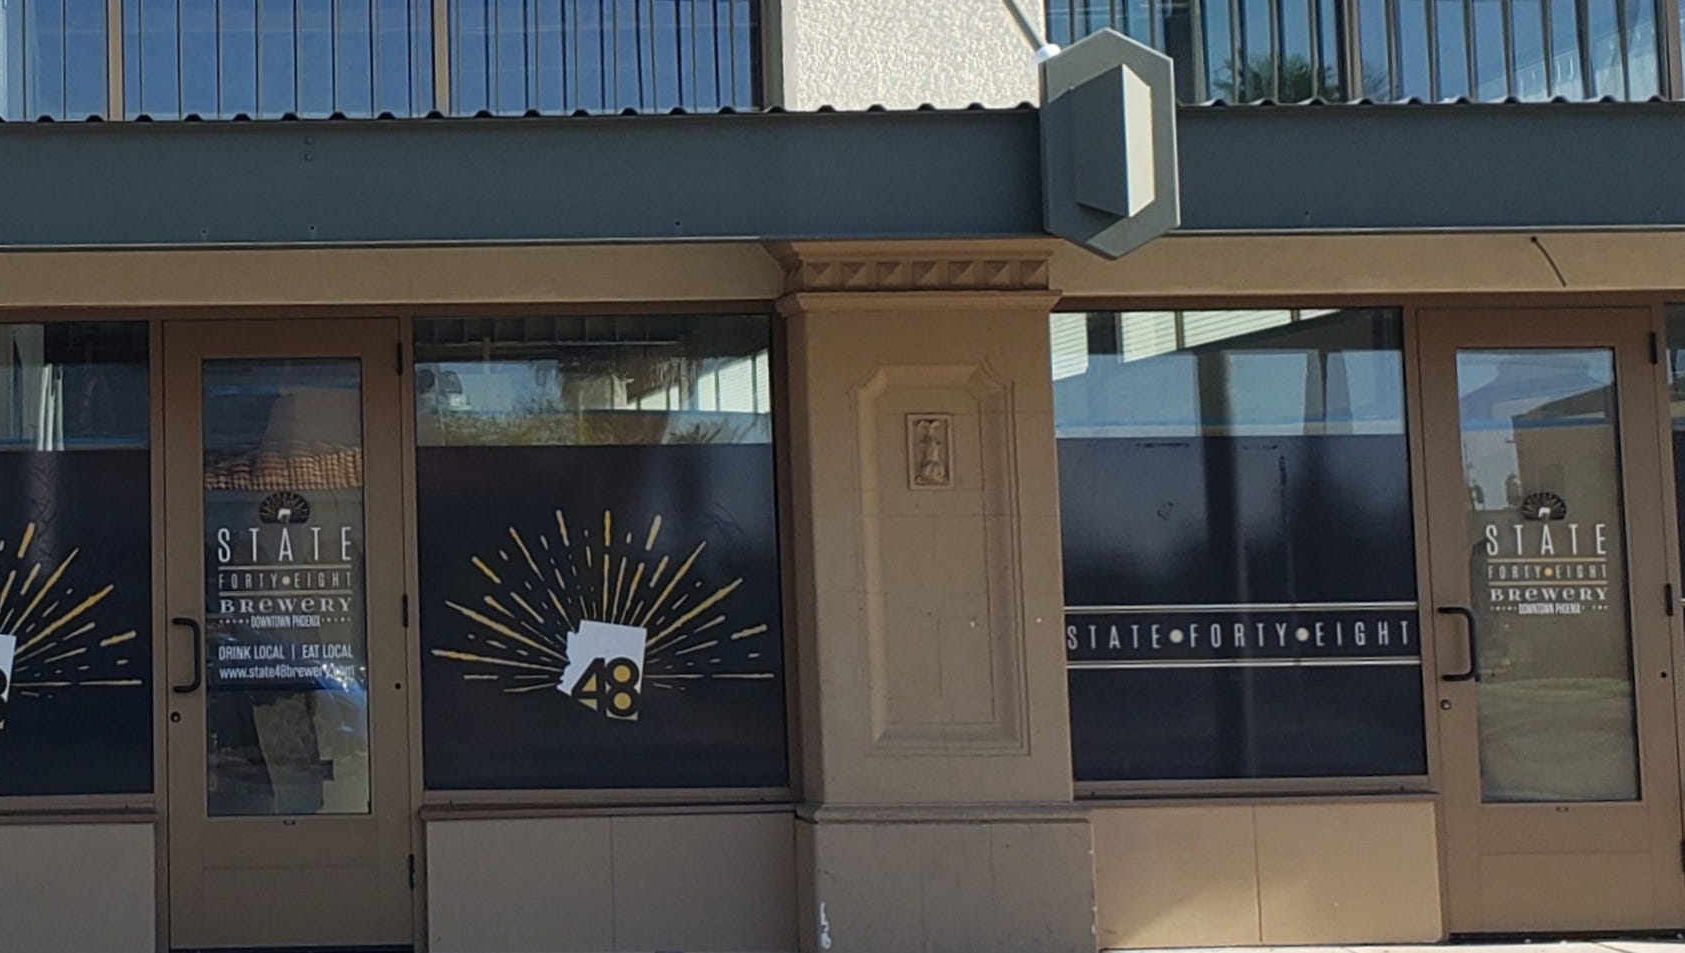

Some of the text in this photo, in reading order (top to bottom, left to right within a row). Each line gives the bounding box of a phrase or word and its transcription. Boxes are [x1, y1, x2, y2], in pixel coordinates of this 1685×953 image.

[217, 526, 352, 563] STATE
[1485, 523, 1608, 556] STATE
[250, 615, 321, 628] DOWNTOWN PHOENIX
[218, 643, 354, 661] DRINK LOCAL EAT LOCAL
[571, 656, 640, 718] 48
